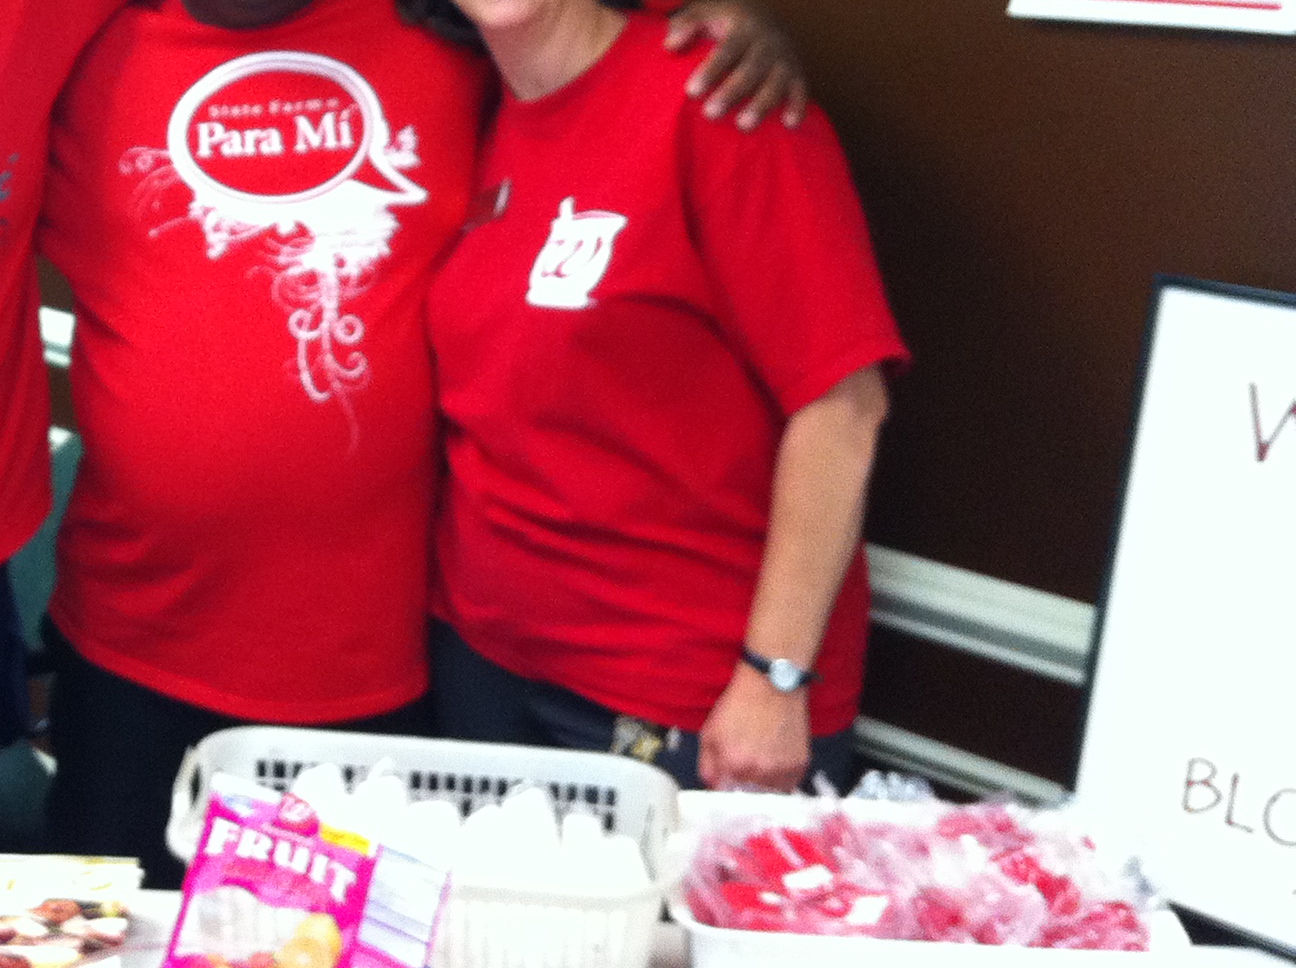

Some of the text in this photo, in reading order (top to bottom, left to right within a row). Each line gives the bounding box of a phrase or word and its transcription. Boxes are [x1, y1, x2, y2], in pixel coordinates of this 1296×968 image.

[195, 103, 357, 159] Para Mí
[204, 816, 357, 904] FRUIT
